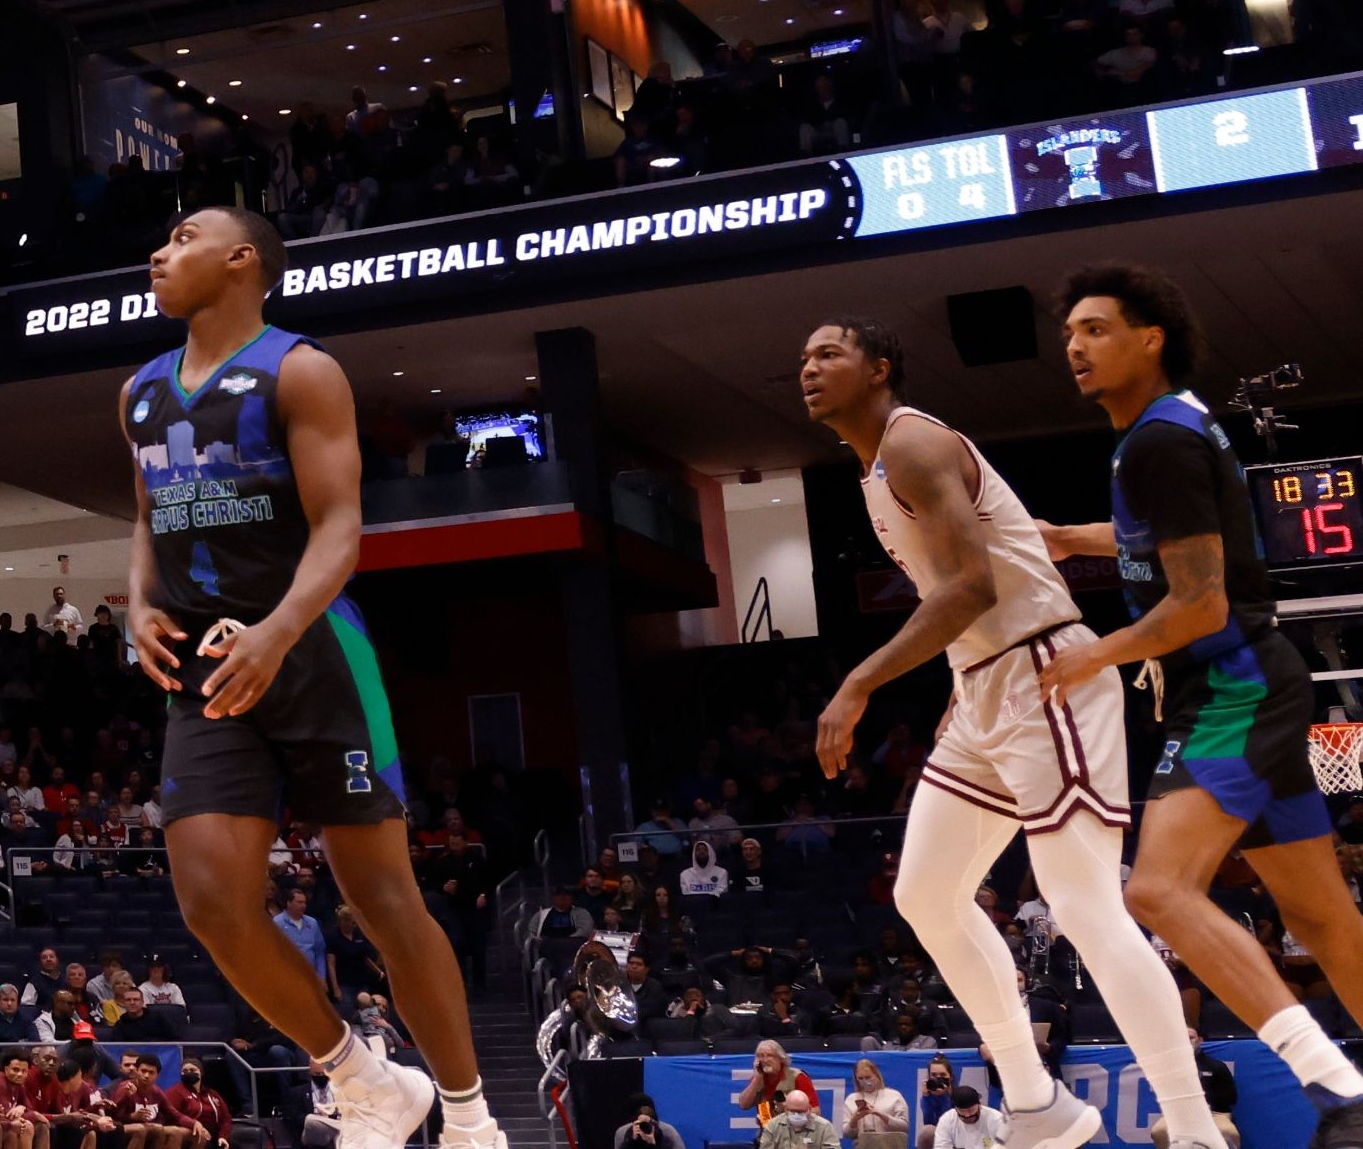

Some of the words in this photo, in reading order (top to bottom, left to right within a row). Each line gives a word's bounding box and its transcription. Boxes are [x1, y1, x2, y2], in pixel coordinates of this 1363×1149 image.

[135, 117, 154, 137] OUR
[1036, 128, 1122, 157] ISLANDERS
[1211, 109, 1250, 148] 2
[882, 153, 932, 190] FLS
[945, 141, 996, 180] TOL
[897, 192, 926, 221] 0
[957, 181, 988, 211] 4
[25, 299, 111, 336] 2022
[283, 248, 505, 297] BASKETBALL
[516, 188, 828, 262] CHAMPIONSHIP
[1274, 463, 1332, 473] DAKTRONICS
[153, 482, 196, 507] TEXAS
[200, 480, 238, 499] A&M
[1273, 475, 1302, 503] 18
[1315, 470, 1355, 500] 33
[192, 495, 274, 528] CHRISTI
[1301, 502, 1354, 554] 15
[16, 862, 28, 870] 115
